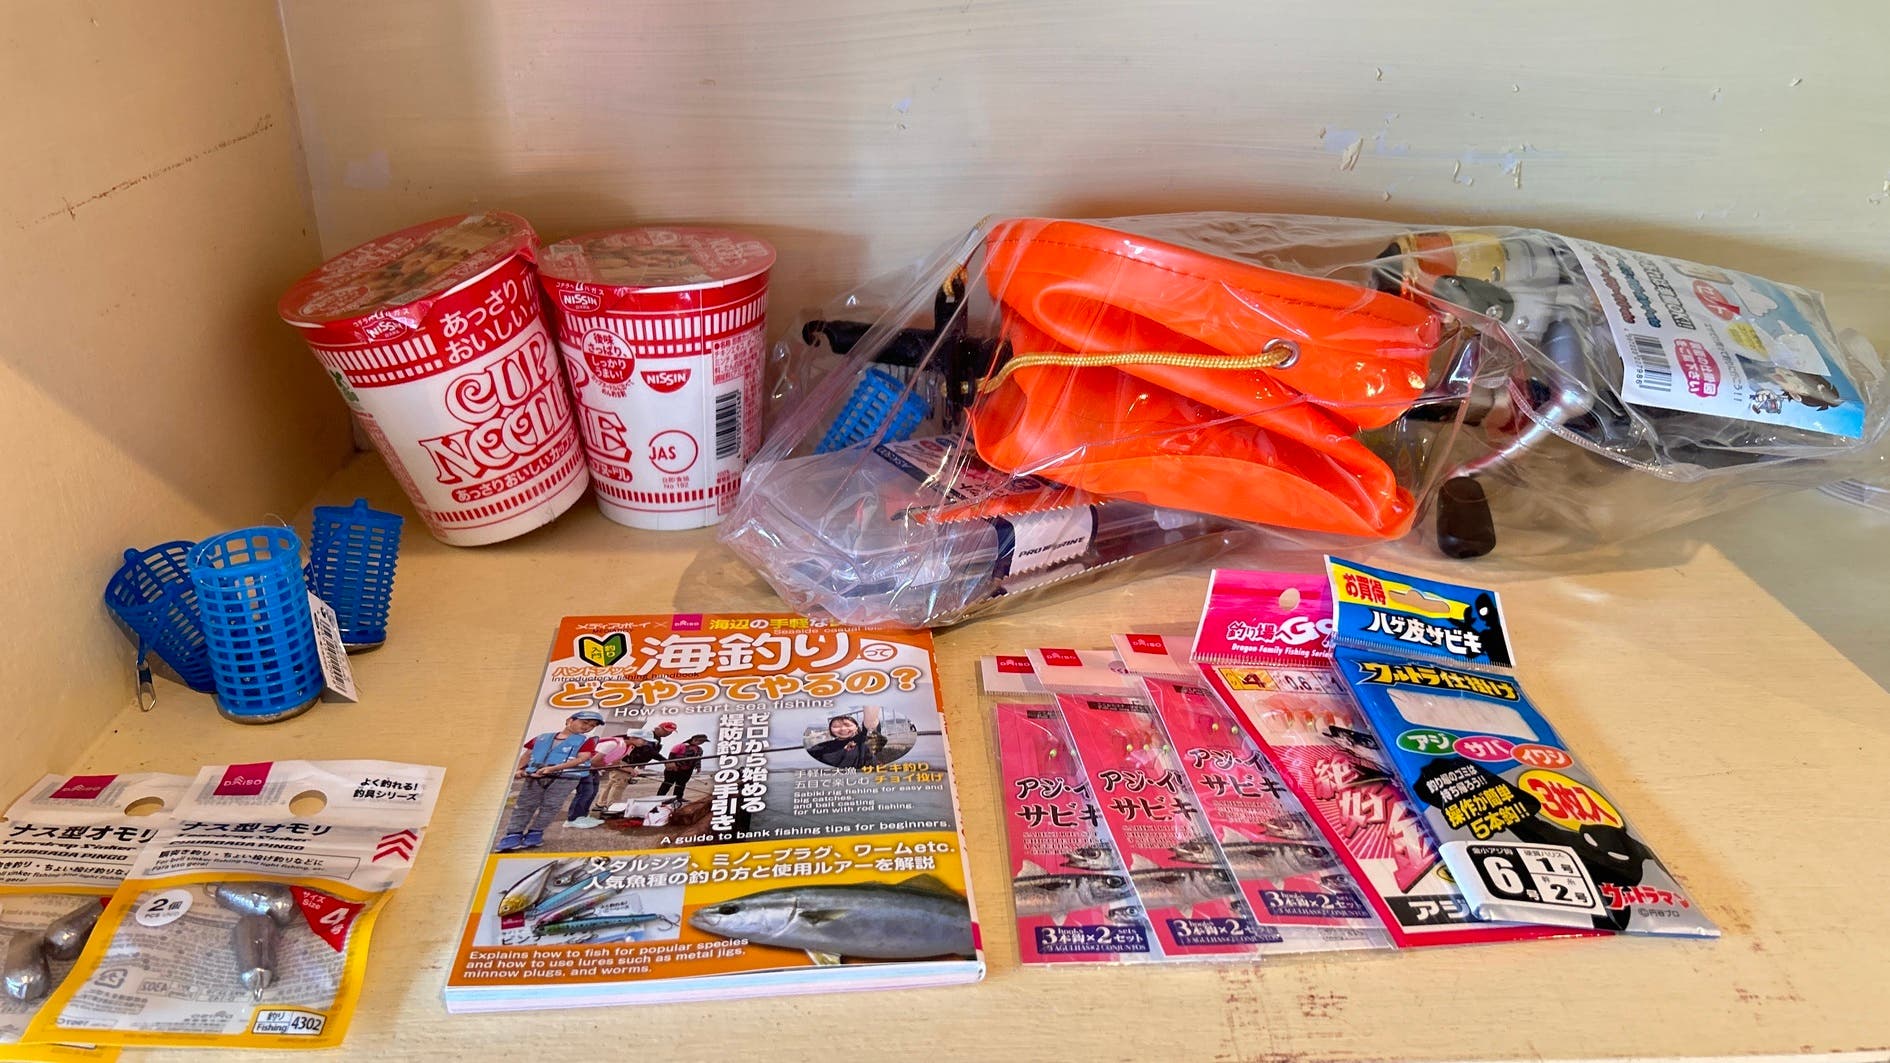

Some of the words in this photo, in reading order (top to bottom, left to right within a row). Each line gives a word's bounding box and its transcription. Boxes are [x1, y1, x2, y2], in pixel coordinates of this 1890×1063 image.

[563, 293, 598, 306] NISSIN
[439, 279, 518, 338] あっさり
[366, 320, 406, 338] NISSI
[444, 304, 529, 364] おいしい
[591, 355, 627, 370] しっかり
[445, 332, 547, 425] CUP
[646, 373, 687, 386] NISSIN
[418, 367, 571, 485] NOODL
[649, 446, 676, 461] JAS
[1018, 548, 1042, 557] PRO
[1343, 572, 1387, 606] お買得
[576, 622, 650, 630] メディアボーイ
[1367, 610, 1482, 656] ハゲ皮サビキ
[866, 648, 892, 657] って
[1132, 639, 1163, 649] DAISO
[1231, 643, 1258, 652] Dragon
[1259, 645, 1283, 656] Family
[1284, 647, 1310, 658] Fishing
[636, 632, 852, 676] 海釣り
[552, 666, 639, 677] ハンドブック
[1000, 659, 1031, 667] DAISO
[552, 675, 613, 683] Introductory
[616, 674, 649, 682] fishing
[651, 671, 701, 680] handbook
[1362, 662, 1518, 700] ウルトラ仕掛け
[548, 666, 922, 709] どうやってやるの?
[614, 707, 655, 717] How
[662, 706, 680, 715] to
[684, 704, 729, 714] start
[735, 702, 767, 711] sea
[773, 699, 834, 710] fishing
[1406, 733, 1450, 750] アジ
[1464, 740, 1509, 758] サバ
[740, 711, 771, 813] ゼロから始める
[1521, 748, 1567, 766] イワシ
[710, 713, 745, 831] 堤防釣りの手引き
[795, 767, 857, 779] 手軽に大漁
[861, 762, 930, 774] サビキ釣り
[1425, 764, 1478, 794] 釣り場のゴミは
[223, 775, 262, 786] DAISO
[360, 778, 419, 791] よく釣れる!
[795, 777, 870, 789] 五目で楽しむ
[874, 773, 945, 785] チョイ投げ
[1200, 774, 1288, 800] サビキ
[1440, 776, 1488, 802] 持ち帰ろう!!
[353, 789, 419, 801] 釣具シリーズ
[793, 790, 825, 798] Sabiki
[845, 787, 879, 795] fishing
[837, 800, 875, 808] casting
[1110, 797, 1198, 821] サビキ
[1444, 783, 1515, 828] 操作が簡単
[1526, 777, 1620, 826] 3枚入
[1016, 802, 1101, 828] サビキ
[9, 823, 159, 844] ナス型オモリ
[182, 822, 332, 836] ナス型オモリ
[660, 836, 671, 845] A
[674, 833, 714, 845] guide
[718, 832, 733, 841] to
[736, 829, 771, 839] bank
[774, 825, 821, 837] fishing
[825, 824, 852, 834] tips
[854, 823, 875, 831] for
[879, 820, 951, 831] beginners.
[3, 839, 76, 850] Teardrop
[80, 843, 137, 851] Sinker
[258, 842, 305, 850] PINGO
[80, 852, 129, 861] PINGO
[1536, 856, 1575, 874] 1号
[581, 856, 936, 891] 人気魚種の釣り方と使用ルアーを解説
[1482, 855, 1541, 901] 6号
[302, 891, 328, 903] サイズ
[1549, 883, 1588, 903] 2号
[1599, 882, 1691, 911] ウルトラマン
[147, 898, 182, 912] 2個
[302, 899, 321, 910] Size
[469, 951, 529, 961] Explains
[532, 950, 562, 959] how
[566, 949, 581, 958] to
[584, 948, 610, 957] fish
[615, 947, 636, 956] for
[639, 944, 692, 955] popular
[696, 939, 749, 950] species
[466, 960, 494, 969] and
[496, 959, 527, 968] how
[531, 959, 546, 968] to
[578, 957, 614, 967] lures
[617, 955, 651, 965] such
[675, 950, 714, 961] metal
[716, 949, 746, 958] jigs,
[463, 970, 520, 979] minnow
[523, 968, 566, 979] plugs,
[570, 967, 598, 976] and
[601, 966, 652, 976] worms.
[266, 1011, 285, 1021] 釣り
[291, 1017, 322, 1031] 4302
[256, 1023, 288, 1033] Fishing
